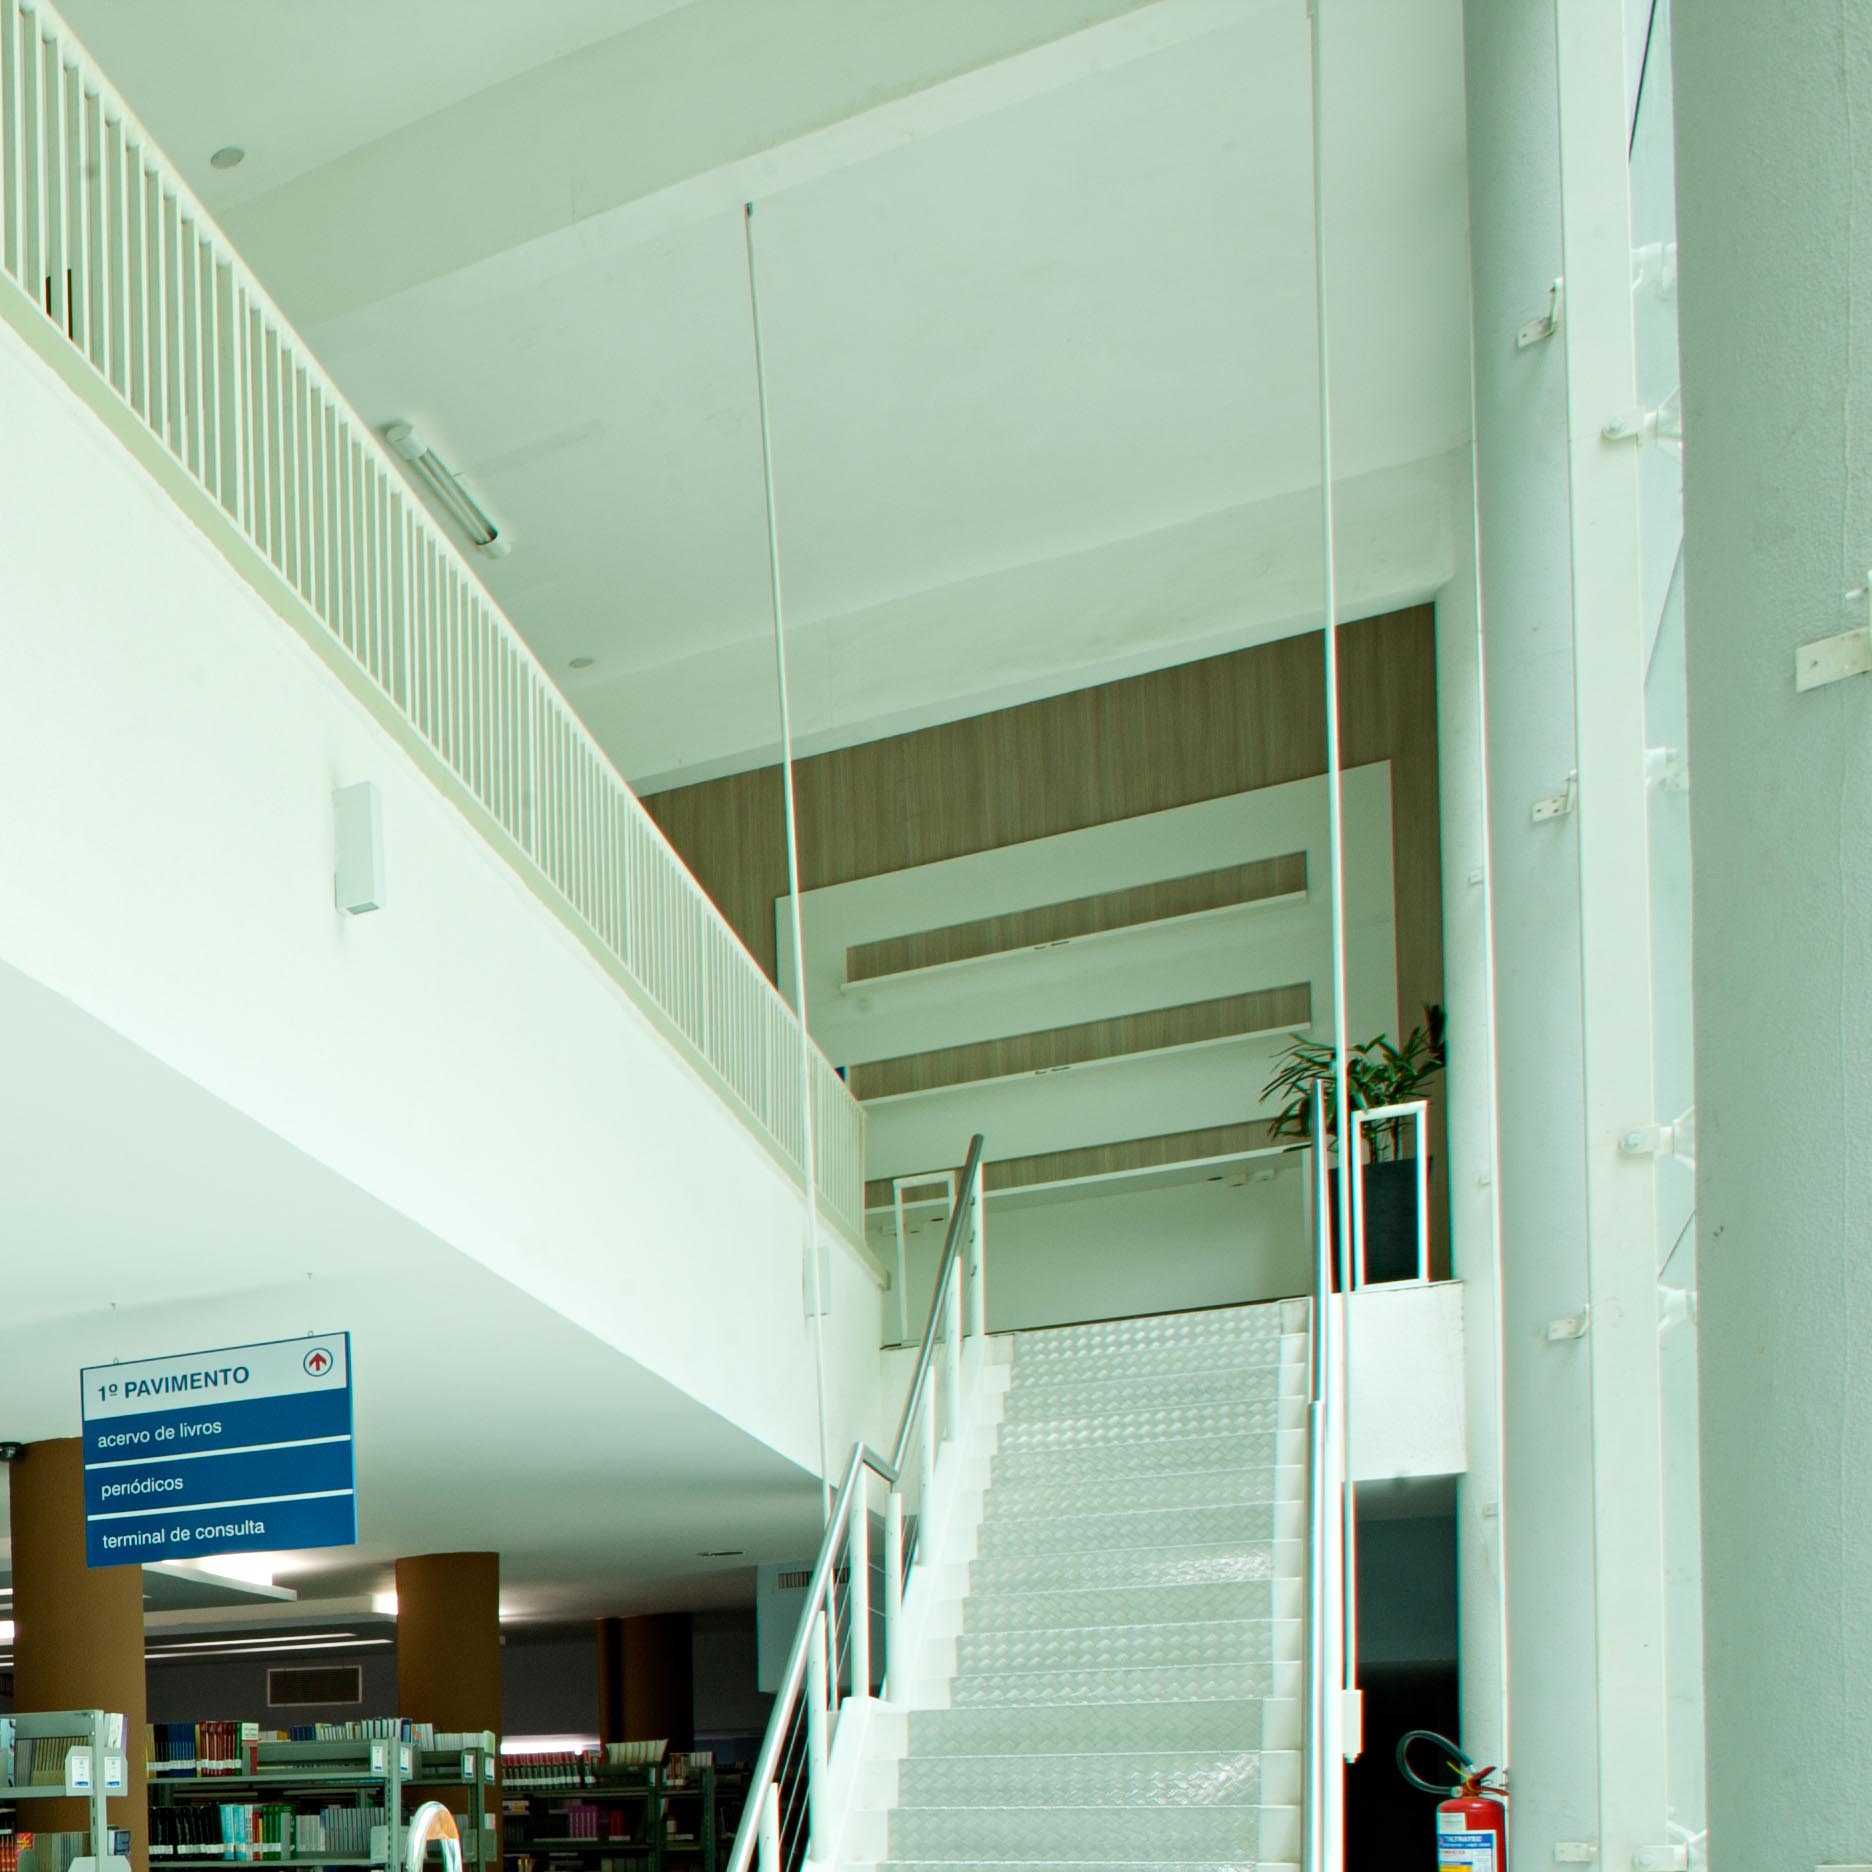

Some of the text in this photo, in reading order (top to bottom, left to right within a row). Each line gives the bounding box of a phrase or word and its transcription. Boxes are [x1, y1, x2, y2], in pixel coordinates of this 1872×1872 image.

[98, 1366, 250, 1402] 1º PAVIMENTO
[98, 1421, 222, 1448] acervo de livros
[101, 1477, 184, 1501] periódicos
[102, 1519, 265, 1549] terminal de consulta
